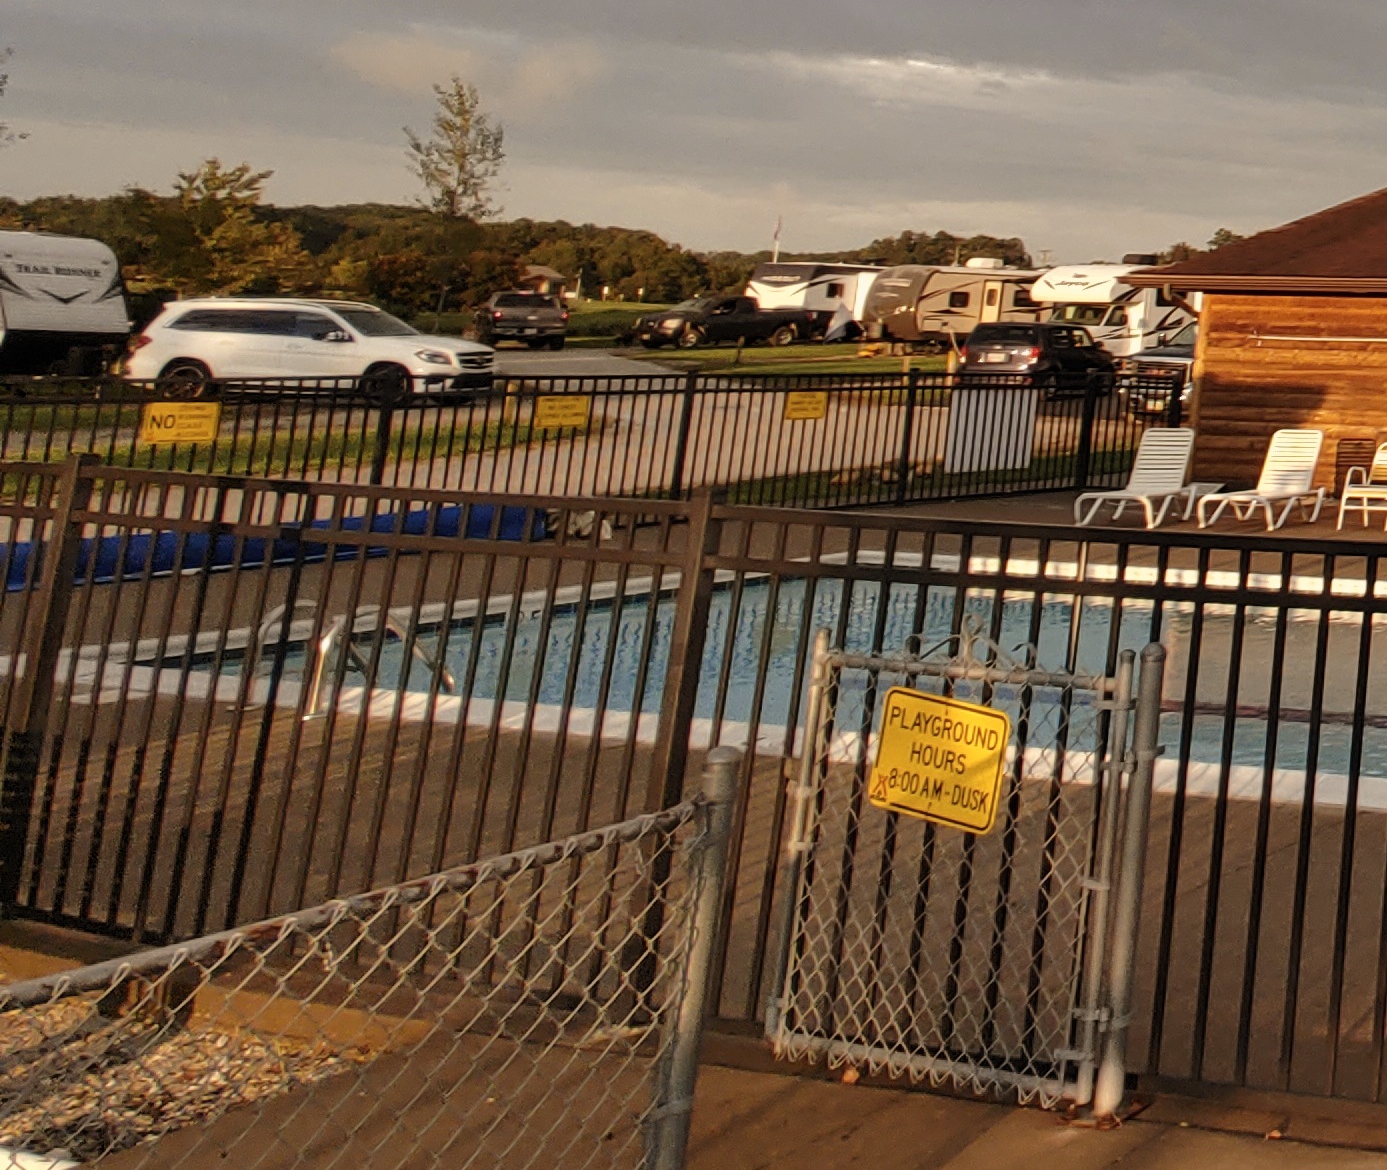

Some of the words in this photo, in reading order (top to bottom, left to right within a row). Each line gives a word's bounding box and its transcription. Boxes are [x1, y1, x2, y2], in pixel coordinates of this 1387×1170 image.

[149, 414, 176, 429] NO
[889, 705, 999, 751] PLAYGROUND
[909, 741, 967, 775] HOURS
